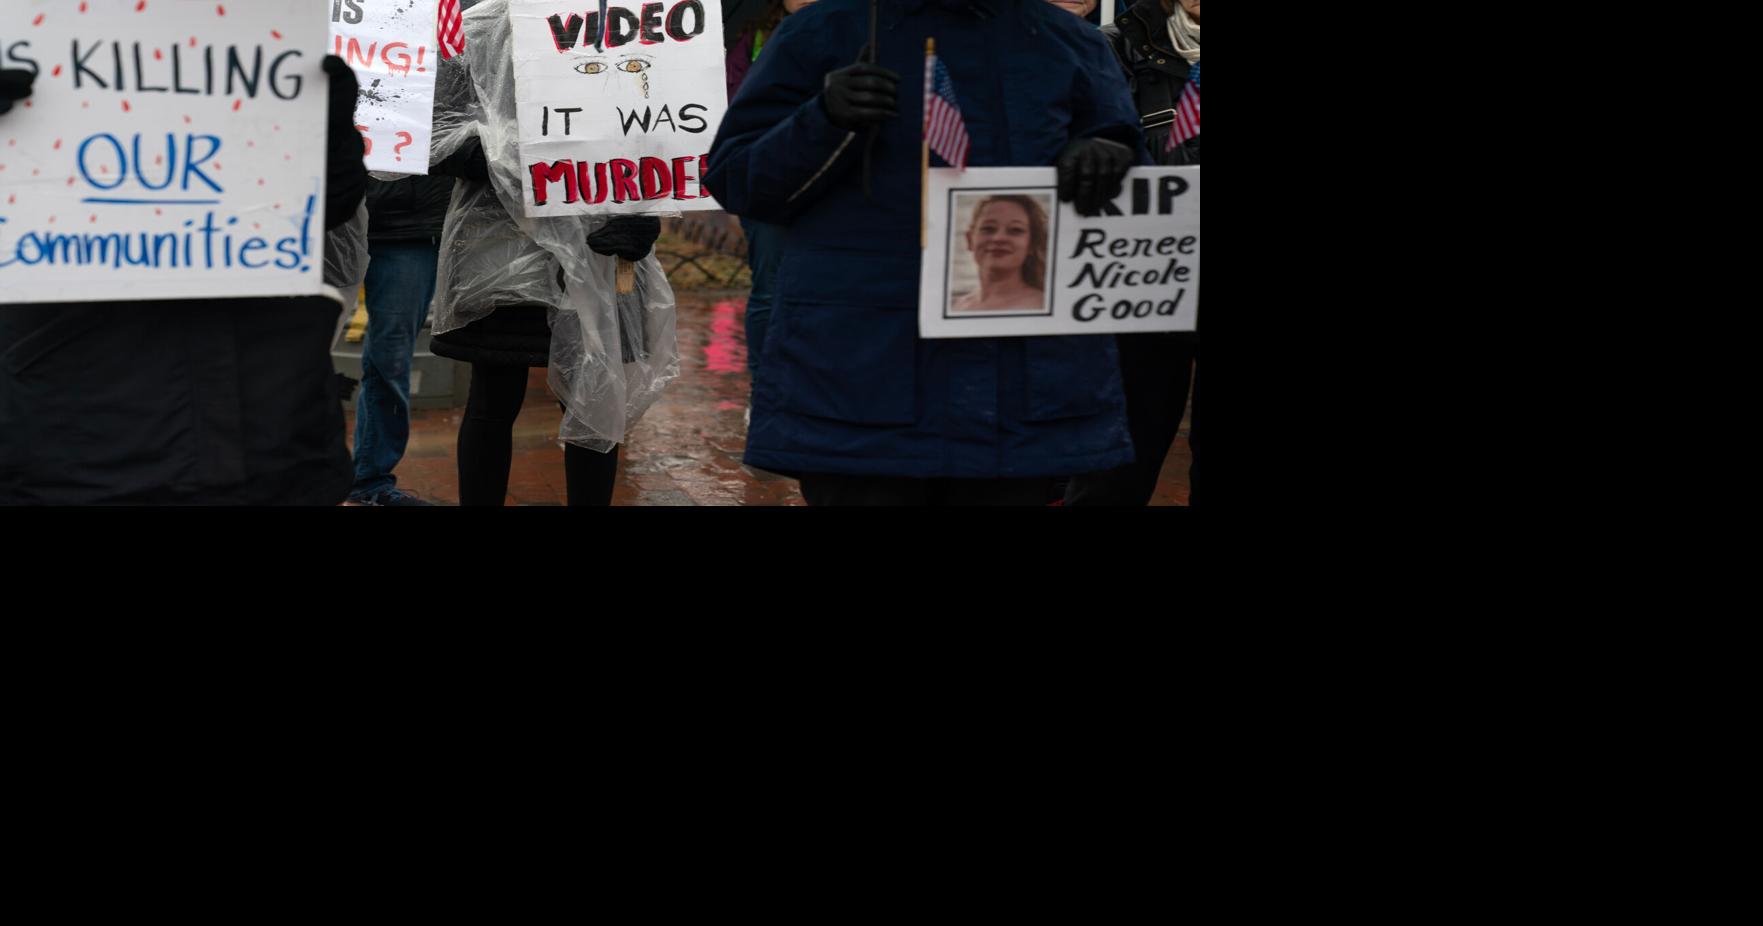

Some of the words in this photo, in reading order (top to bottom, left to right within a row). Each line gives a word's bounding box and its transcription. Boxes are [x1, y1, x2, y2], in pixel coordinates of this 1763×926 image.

[546, 0, 705, 53] VIDEO
[71, 39, 304, 100] KILLING
[541, 106, 583, 136] IT
[616, 103, 708, 136] WAS
[77, 133, 224, 193] OUR
[1068, 228, 1197, 259] Renee
[1067, 258, 1192, 289] Nicole
[1072, 288, 1185, 322] Good
